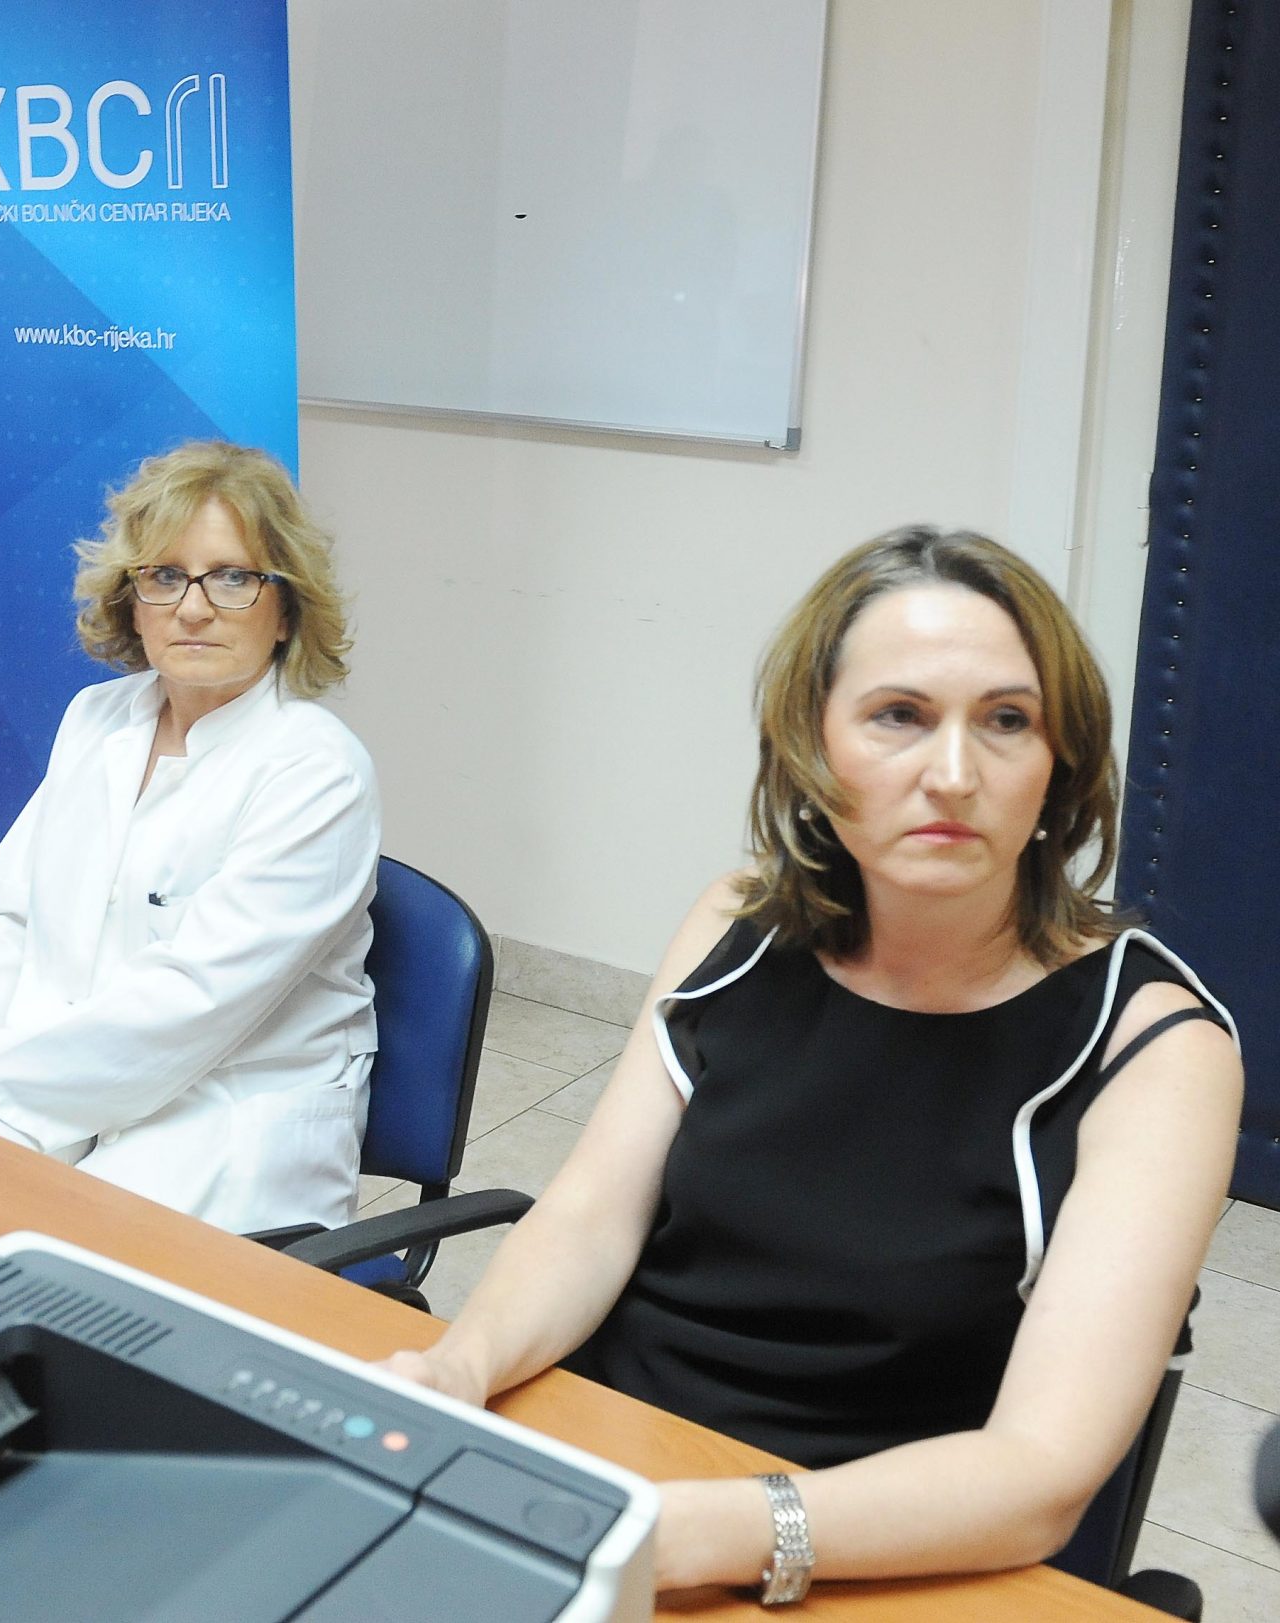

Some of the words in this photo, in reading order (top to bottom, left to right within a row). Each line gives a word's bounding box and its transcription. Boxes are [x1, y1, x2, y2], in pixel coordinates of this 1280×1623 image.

[22, 199, 96, 222] BOLNIČKI
[99, 202, 168, 222] CENTAR
[171, 202, 231, 222] RIJEKA
[14, 324, 177, 352] www.kbc-rijeka.hr
